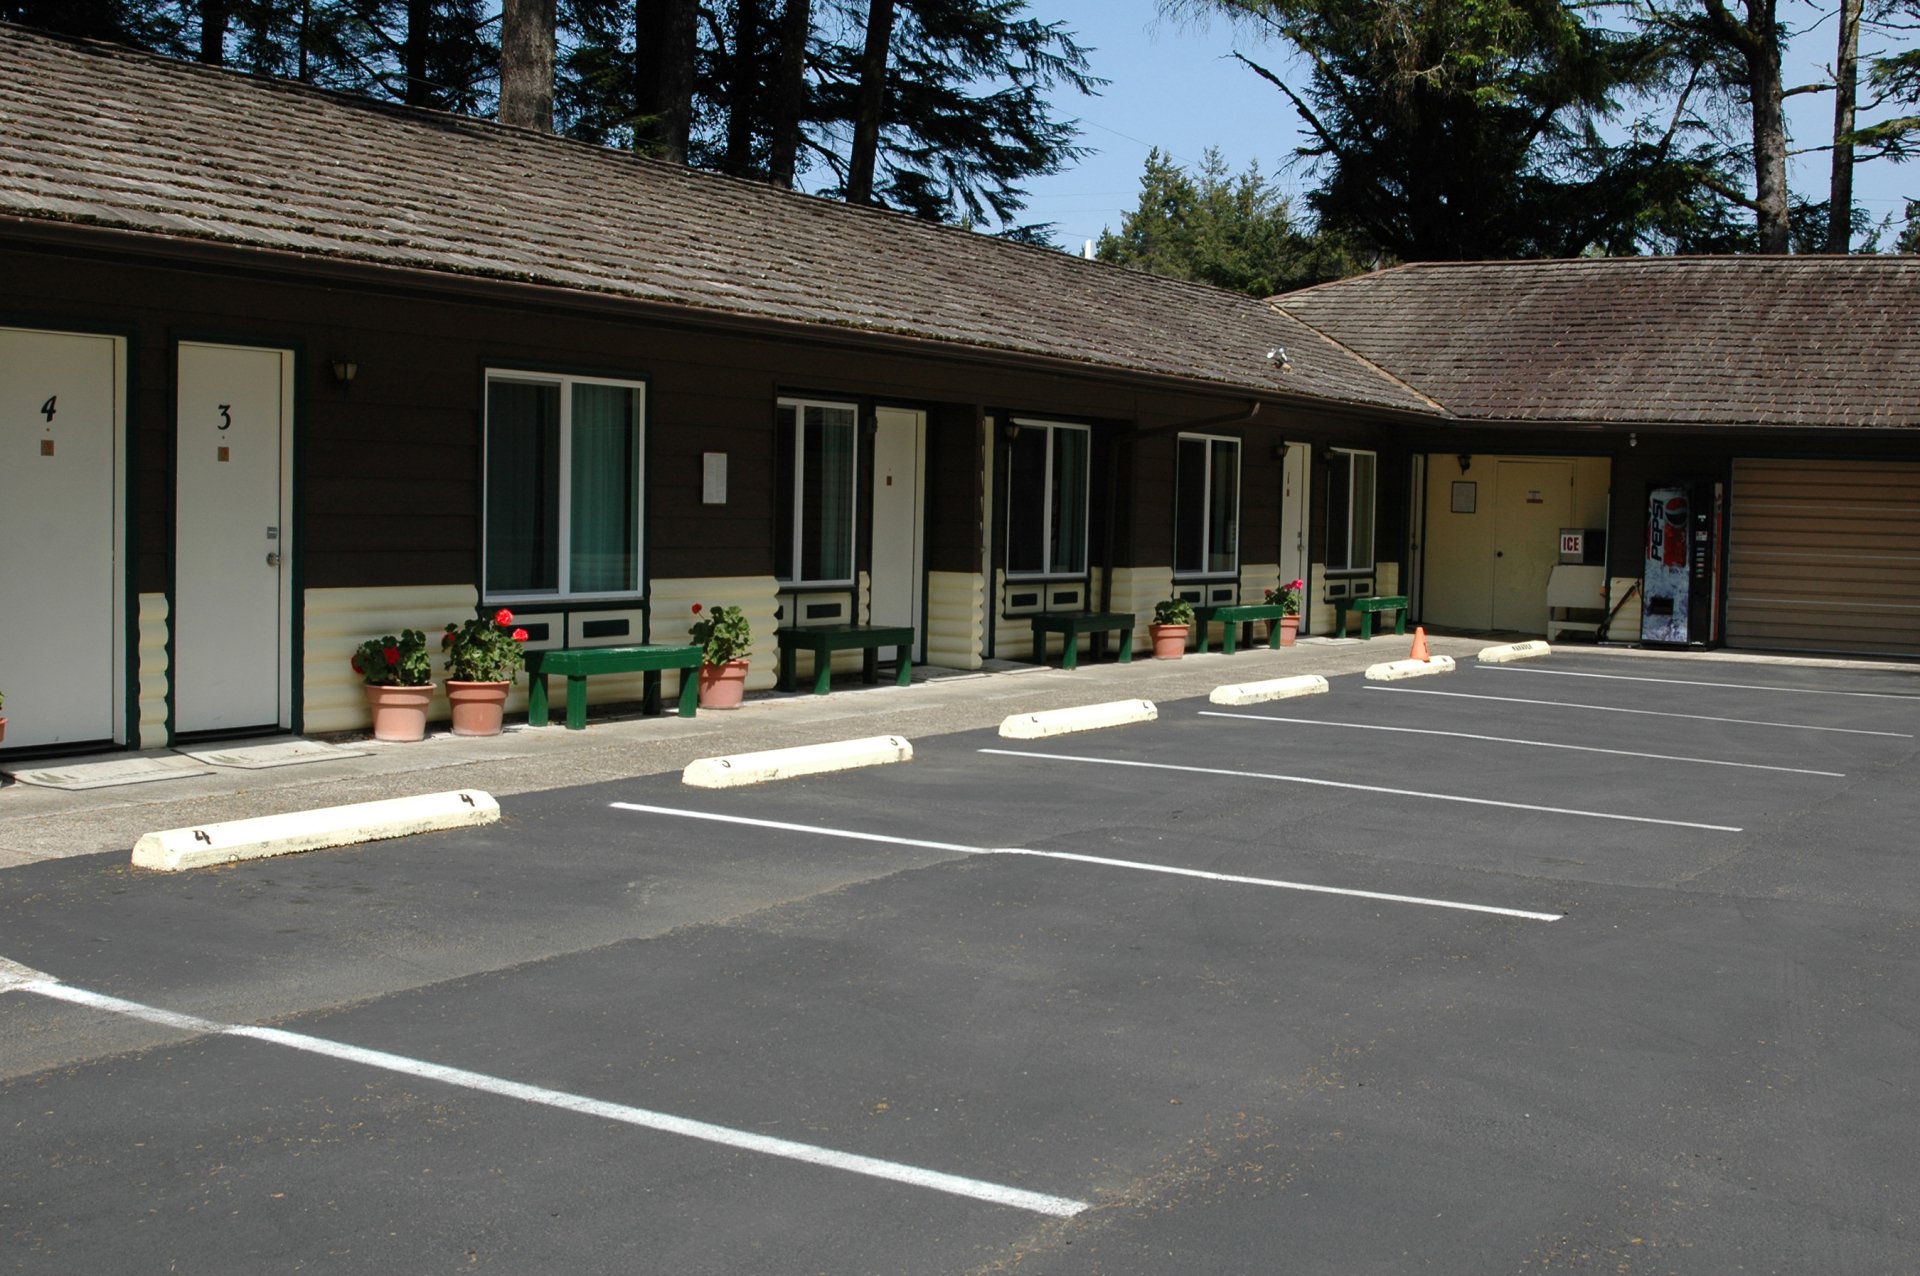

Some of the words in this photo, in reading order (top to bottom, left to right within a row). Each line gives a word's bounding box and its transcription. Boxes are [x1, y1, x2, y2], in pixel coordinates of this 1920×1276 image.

[41, 395, 57, 423] 4
[217, 404, 231, 430] 3
[1650, 498, 1665, 562] PEPSI
[1562, 536, 1580, 551] ICE
[458, 793, 475, 807] 4
[192, 830, 211, 845] 4
